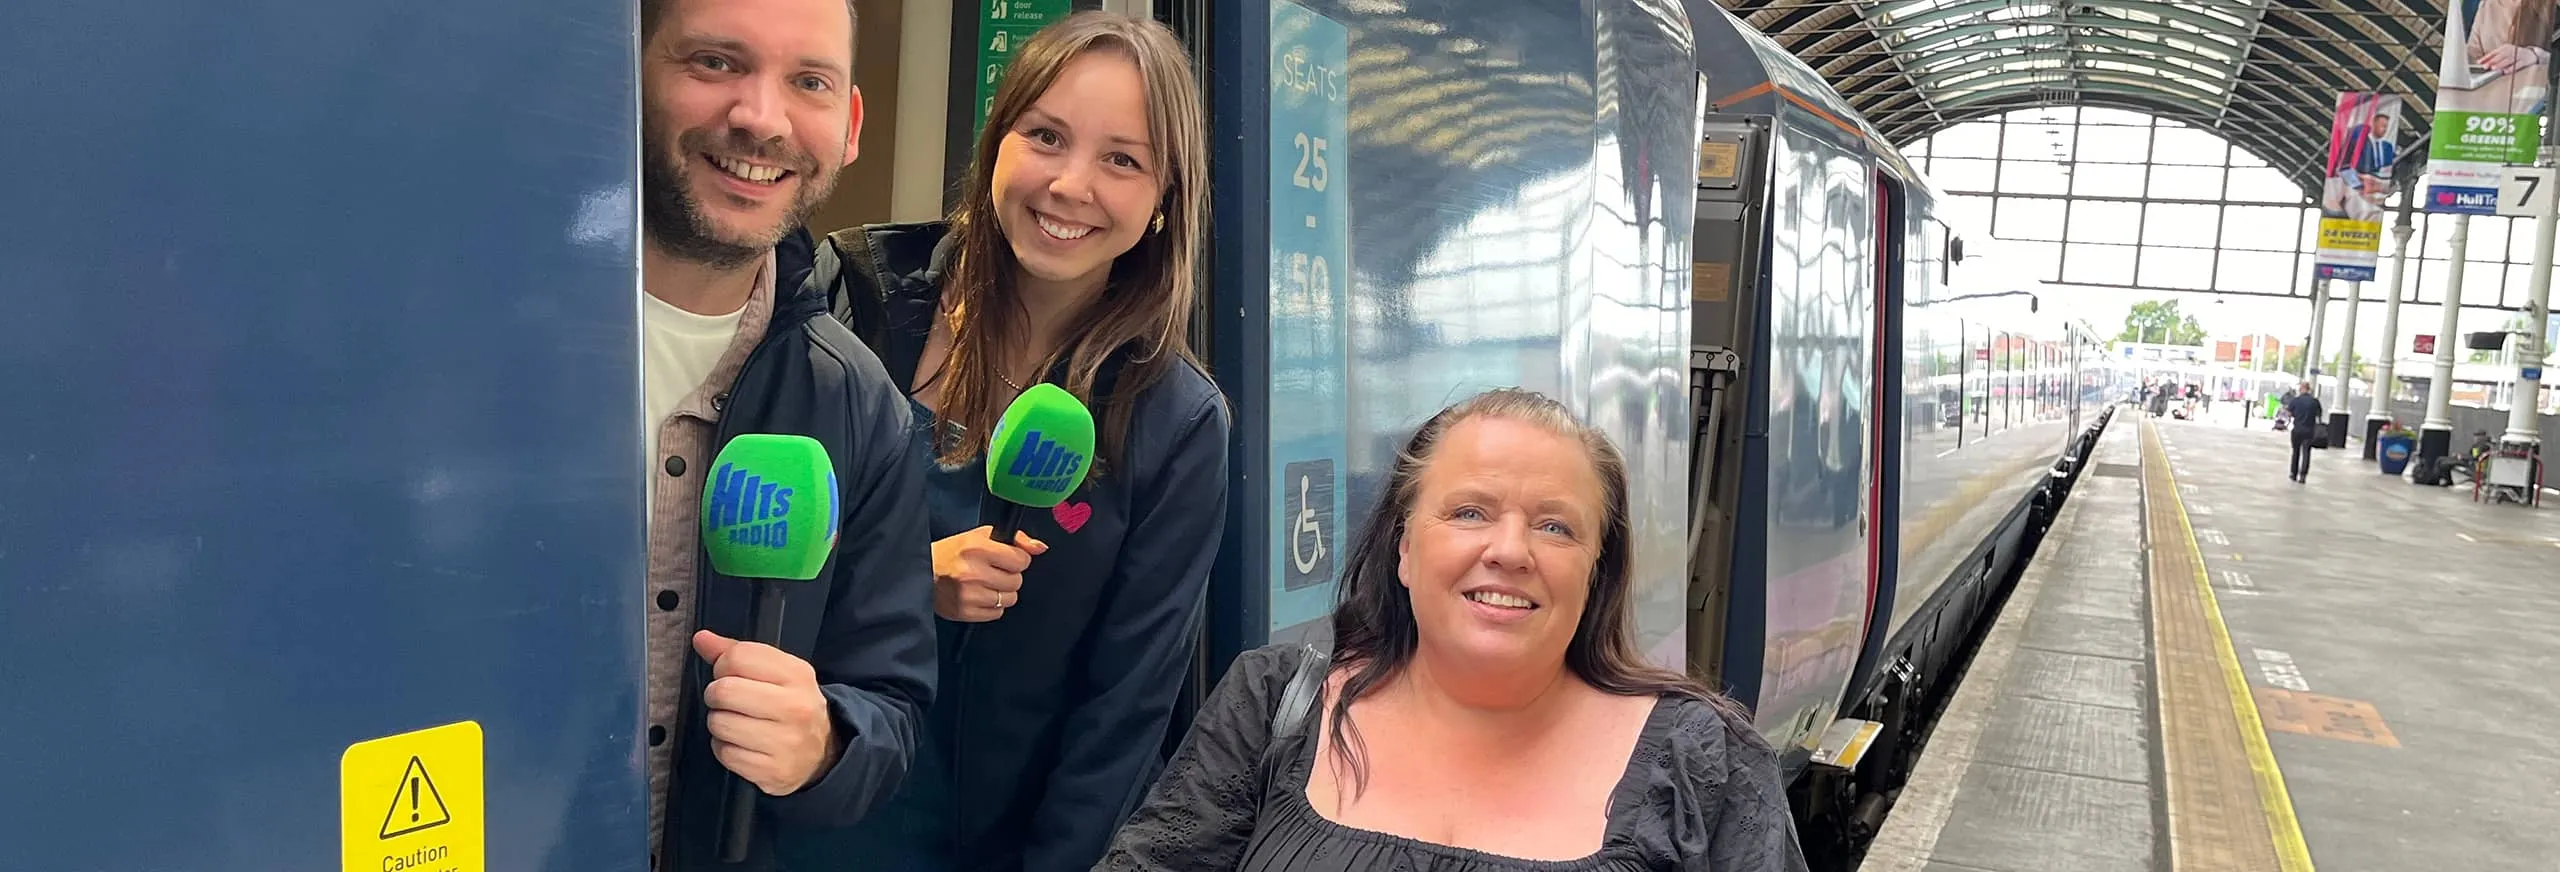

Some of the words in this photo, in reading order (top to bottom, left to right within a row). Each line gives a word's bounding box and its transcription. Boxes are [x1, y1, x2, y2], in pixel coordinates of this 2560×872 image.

[1014, 1, 1032, 9] door
[1283, 53, 1338, 102] SEATS
[2460, 134, 2517, 145] GREENER
[2466, 115, 2516, 134] 90%
[1293, 131, 1329, 192] 25
[2514, 176, 2540, 207] 7
[1291, 251, 1330, 319] 50
[1008, 430, 1084, 477] HITS
[708, 462, 794, 532] HITS
[728, 519, 789, 550] RADIO
[382, 845, 448, 872] Caution
